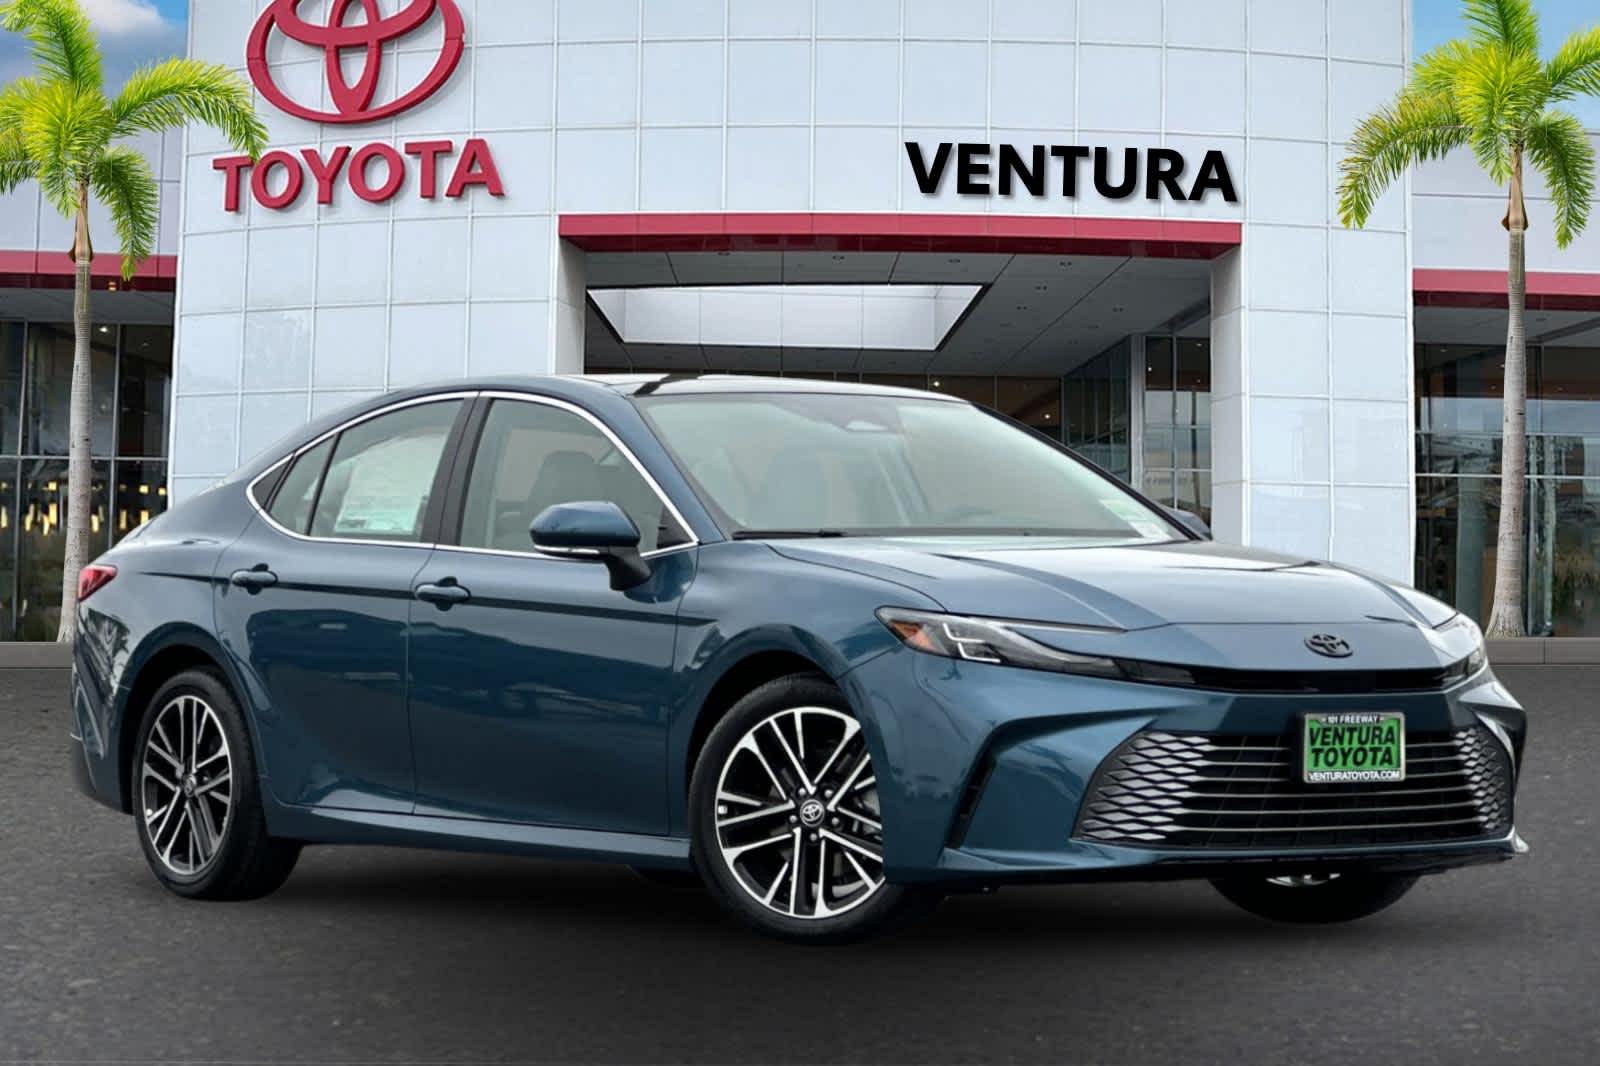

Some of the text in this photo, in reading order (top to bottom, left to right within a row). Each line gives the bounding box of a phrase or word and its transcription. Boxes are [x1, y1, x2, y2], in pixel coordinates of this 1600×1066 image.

[211, 138, 505, 213] TOYOTA
[903, 141, 1240, 204] VENTURA
[1339, 714, 1378, 724] FREEWAY
[1309, 725, 1395, 747] VENTURA
[1311, 747, 1394, 767] TOYOTA
[1308, 770, 1401, 781] VENTURATOYOTA.COM
